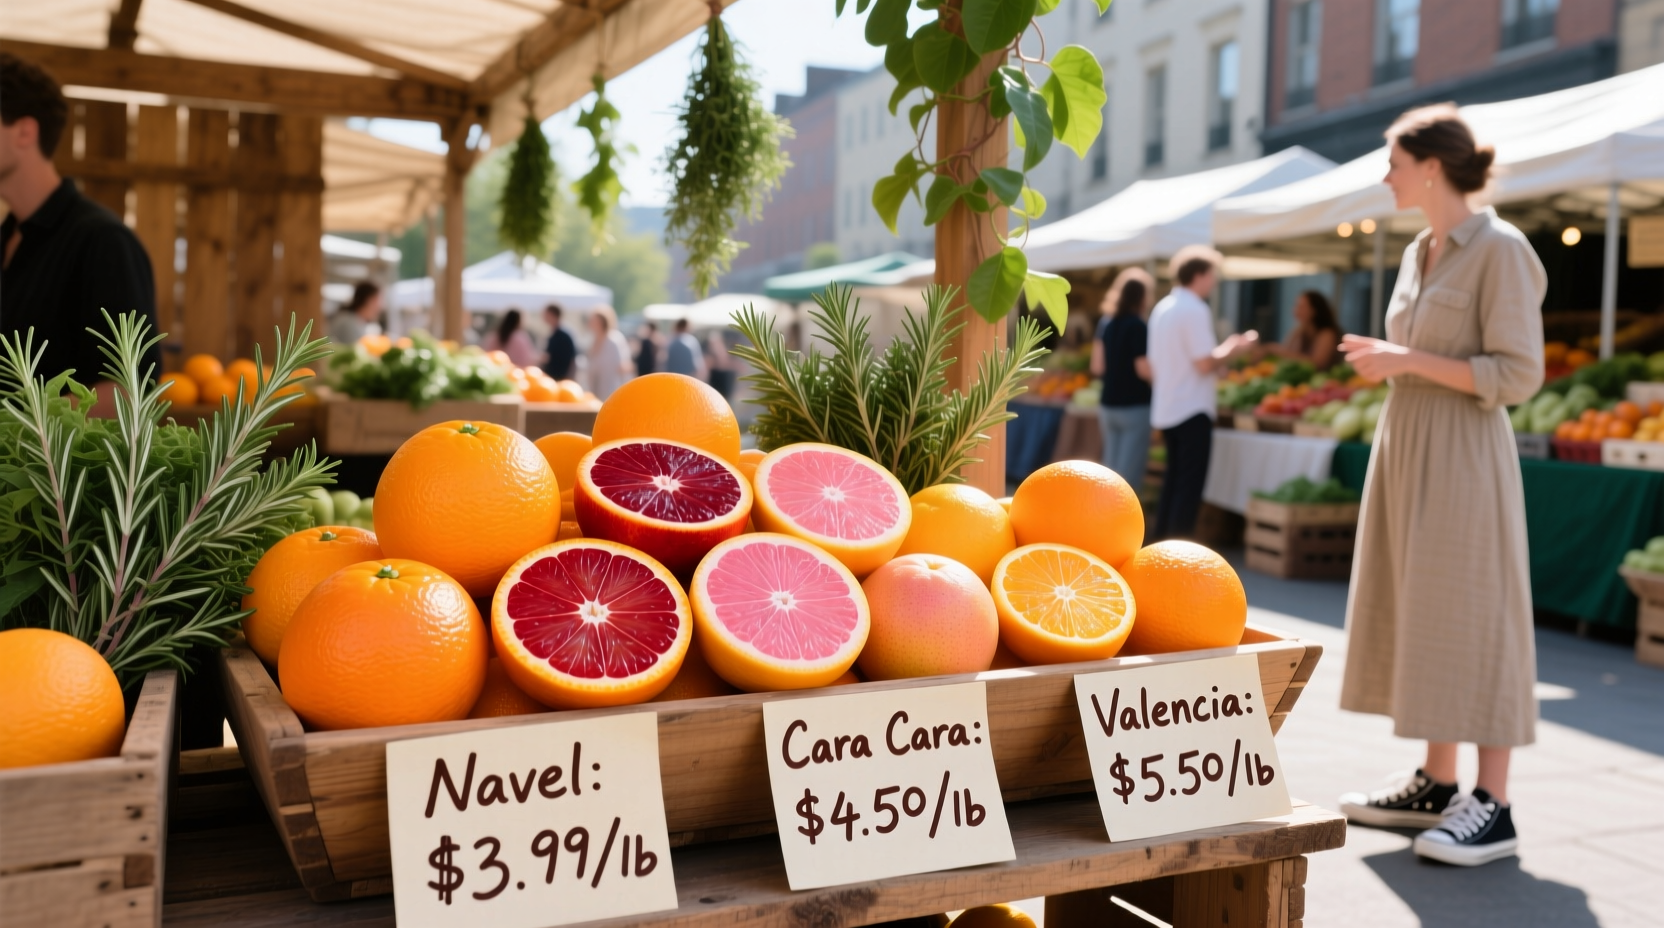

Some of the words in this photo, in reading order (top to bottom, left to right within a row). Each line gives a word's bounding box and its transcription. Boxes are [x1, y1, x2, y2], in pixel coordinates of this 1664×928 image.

[781, 719, 873, 770] Cara
[885, 710, 982, 756] Cara:
[1090, 685, 1254, 738] Valencia:
[424, 741, 602, 819] Navel:
[1109, 738, 1275, 805] $5.50/lb
[795, 770, 987, 845] $4.50/lb
[427, 816, 658, 906] $3.99/lb
